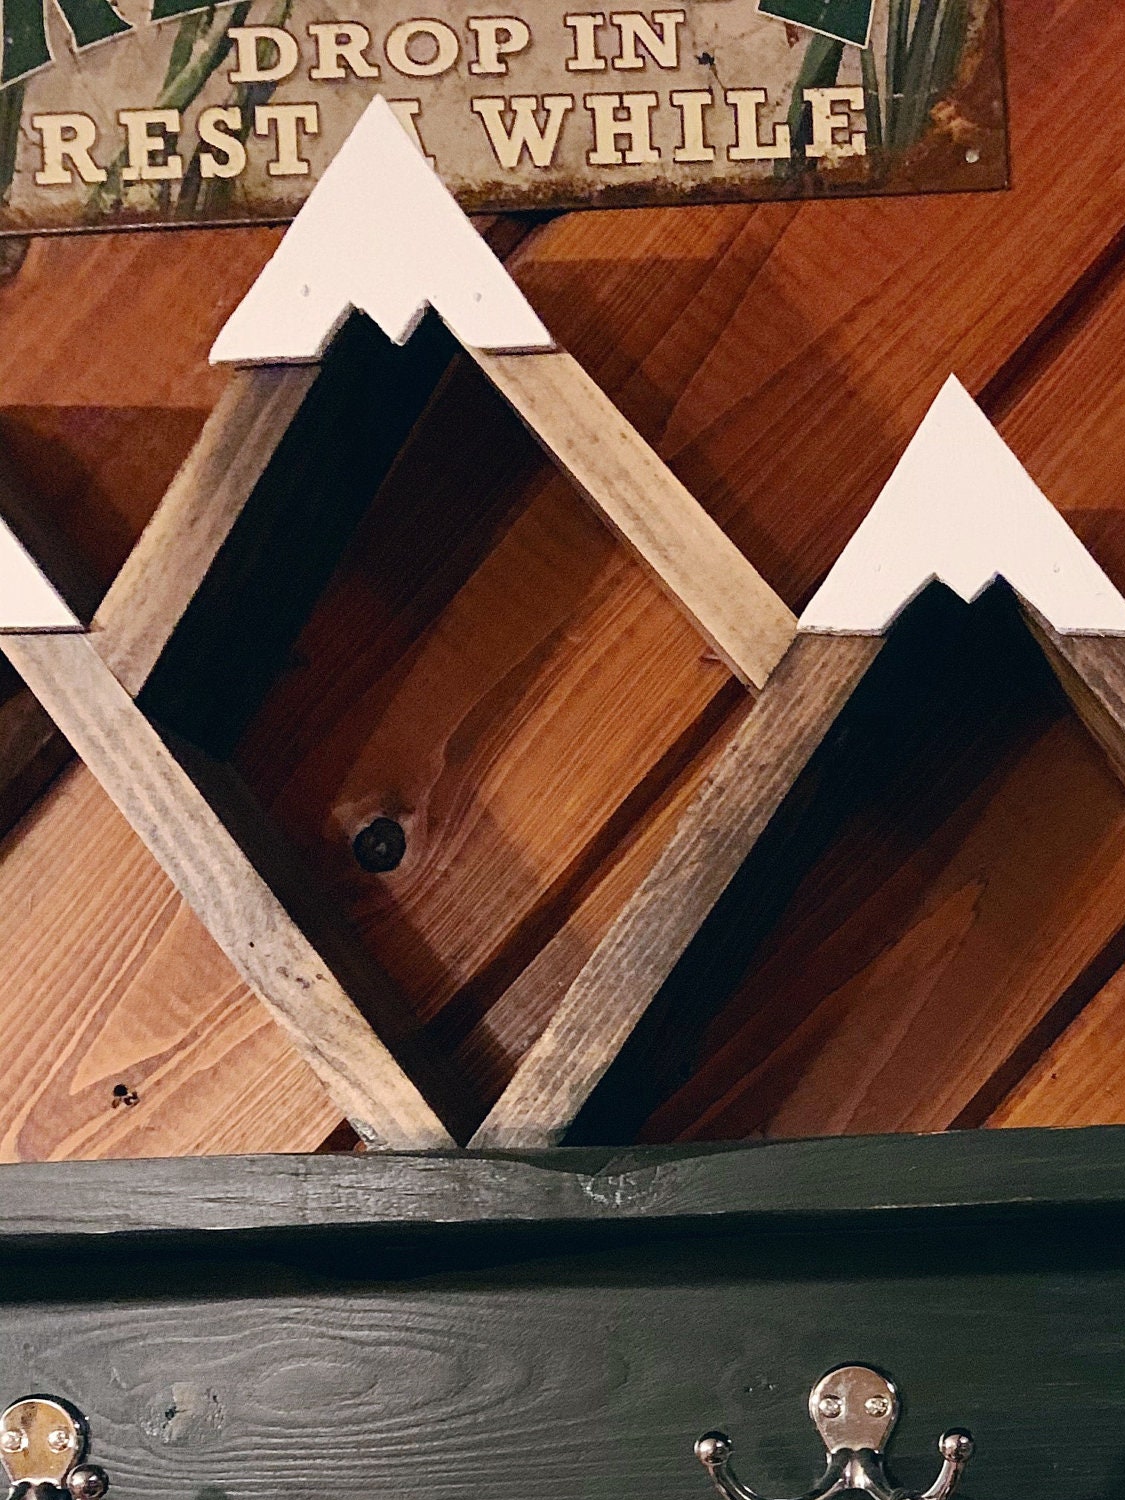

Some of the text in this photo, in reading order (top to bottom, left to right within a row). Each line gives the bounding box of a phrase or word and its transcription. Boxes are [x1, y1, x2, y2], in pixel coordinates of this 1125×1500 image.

[228, 16, 531, 84] DROP
[565, 9, 685, 70] IN
[33, 104, 320, 184] REST
[471, 84, 867, 169] WHILE
